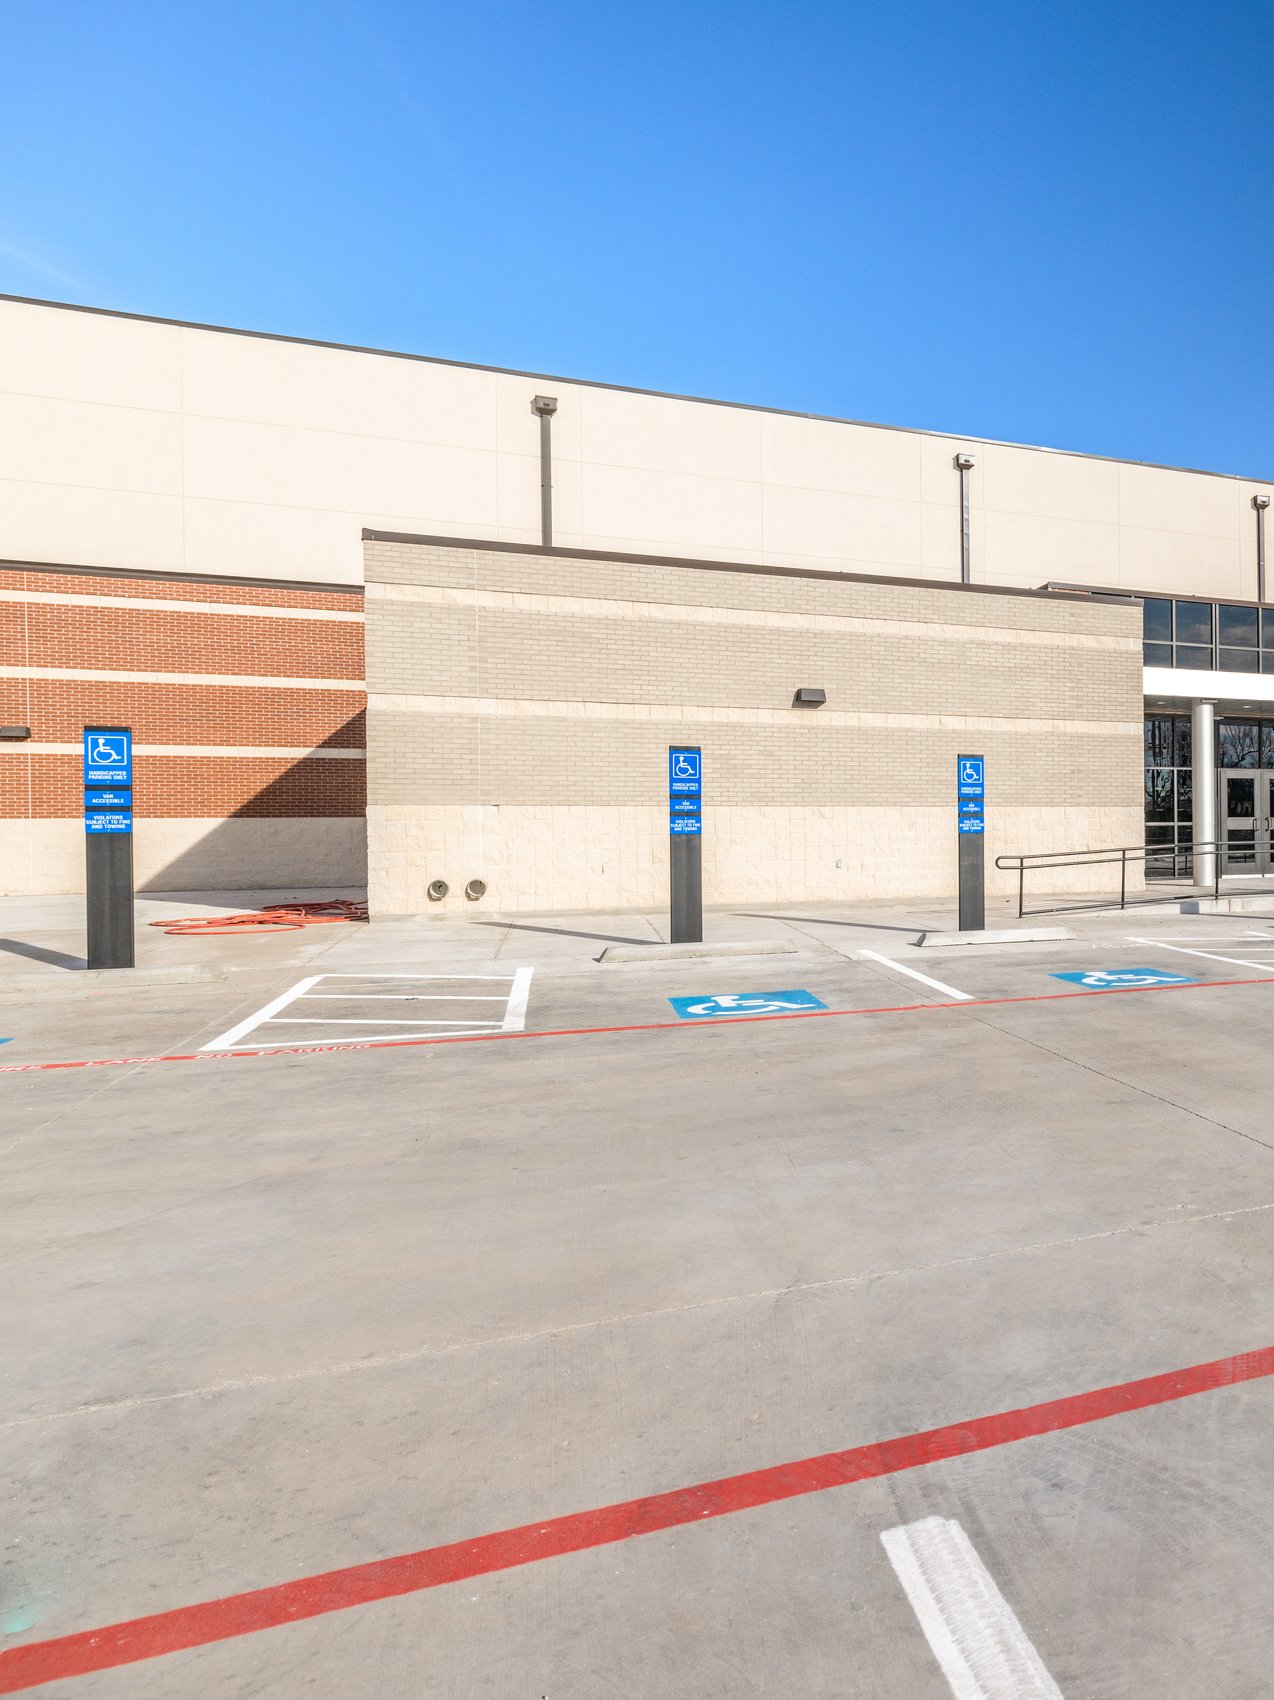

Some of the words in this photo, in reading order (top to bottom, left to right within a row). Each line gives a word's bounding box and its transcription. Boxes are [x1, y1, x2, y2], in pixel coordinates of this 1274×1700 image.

[0, 1064, 41, 1072] IRE
[85, 1056, 160, 1066] LANE
[258, 1044, 371, 1056] PARKING
